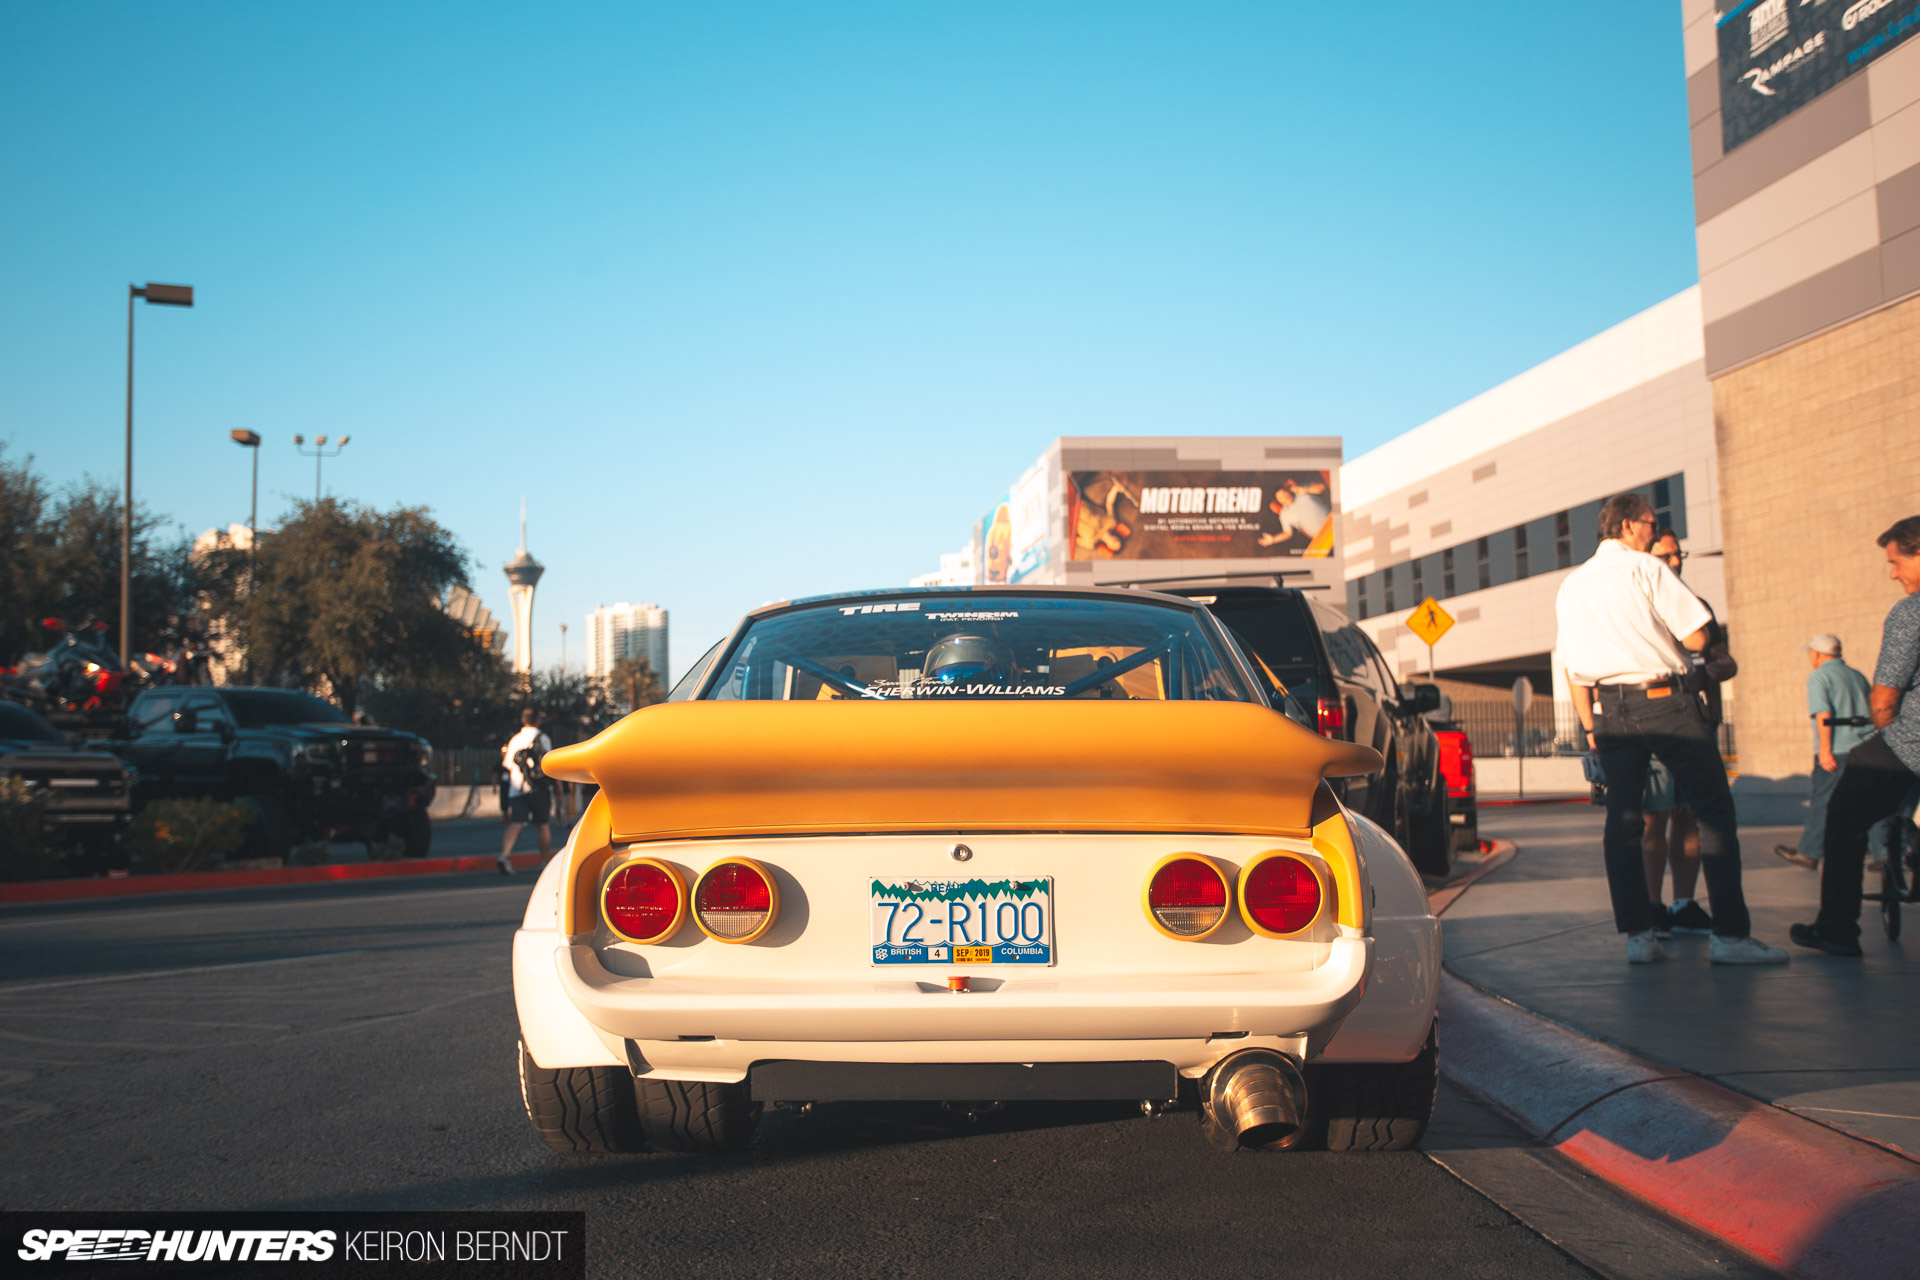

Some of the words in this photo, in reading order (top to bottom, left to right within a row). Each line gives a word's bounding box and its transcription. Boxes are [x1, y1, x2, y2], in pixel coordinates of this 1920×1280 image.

[1737, 29, 1826, 95] RAMPAGE
[1140, 487, 1262, 513] MOTORTREND
[838, 602, 921, 616] TIRE
[925, 612, 1019, 620] TWINRIM
[861, 683, 1066, 698] SHERWIN-WILLIAMS
[930, 883, 989, 893] BEAUTIFUL
[877, 902, 1043, 943] 72-R100
[890, 948, 922, 956] BRITISH
[934, 949, 941, 958] 4
[956, 949, 970, 957] SEP
[974, 949, 990, 957] 2019
[1001, 947, 1044, 955] COLUMBIA
